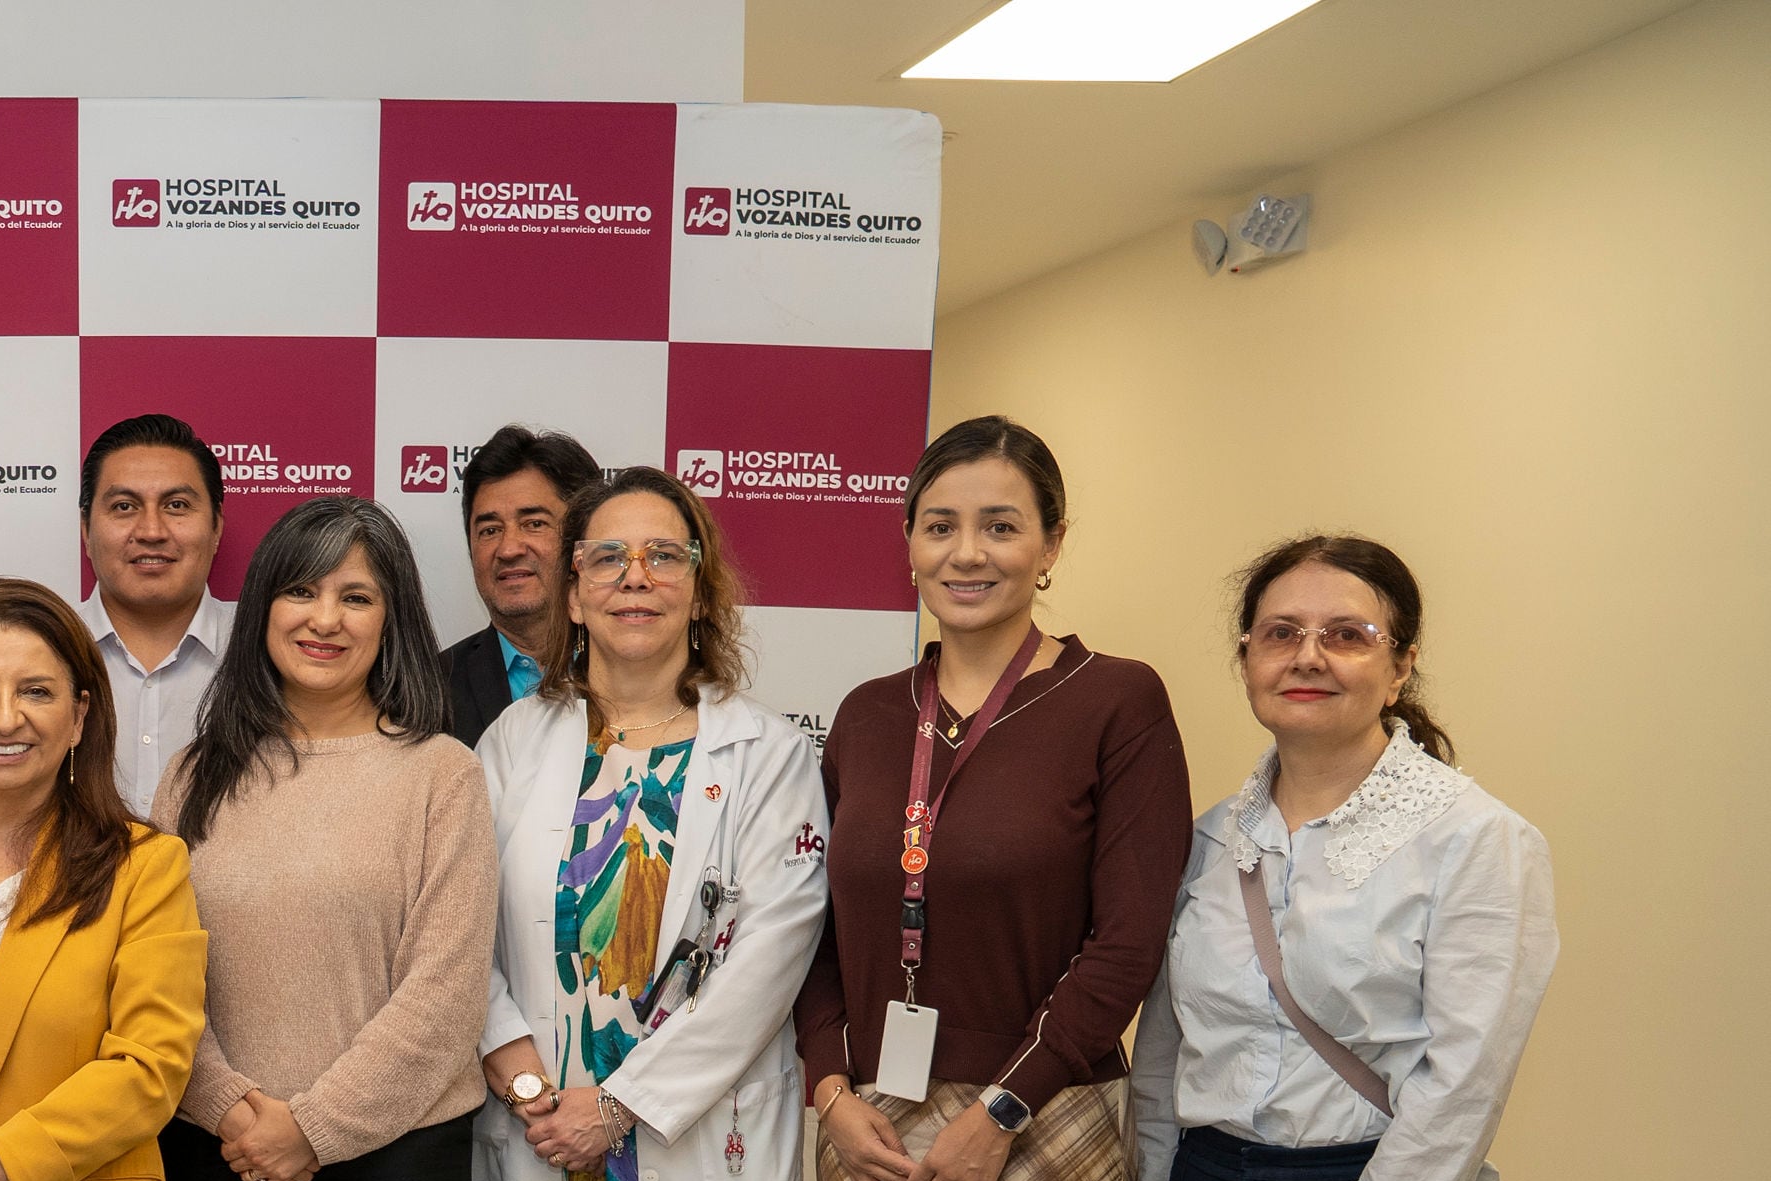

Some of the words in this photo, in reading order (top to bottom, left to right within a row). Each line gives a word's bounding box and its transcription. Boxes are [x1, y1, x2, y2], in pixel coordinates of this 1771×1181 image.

[165, 178, 285, 196] HOSPITAL
[460, 182, 578, 201] HOSPITAL
[736, 188, 850, 210] HOSPITAL
[166, 199, 286, 215] VOZANDES
[292, 200, 360, 219] QUITO
[460, 202, 579, 220] VOZANDES
[584, 204, 651, 223] QUITO
[7, 220, 22, 228] del
[24, 220, 62, 228] Ecuador
[185, 220, 211, 229] gloria
[228, 220, 248, 228] Dios
[250, 222, 256, 230] y
[268, 220, 303, 229] servicio
[305, 221, 320, 229] del
[469, 223, 478, 231] la
[479, 223, 505, 233] gloria
[507, 224, 519, 232] de
[521, 224, 541, 232] Dios
[543, 226, 549, 234] y
[560, 224, 596, 233] servicio
[597, 225, 611, 234] del
[613, 226, 650, 234] Ecuador
[736, 208, 850, 228] VOZANDES
[856, 214, 921, 232] QUITO
[744, 229, 751, 237] la
[754, 230, 779, 239] gloria
[780, 231, 792, 239] de
[794, 231, 814, 240] Dios
[833, 234, 867, 242] servicio
[884, 236, 920, 244] Ecuador
[214, 445, 278, 462] PITAL
[728, 450, 841, 470] HOSPITAL
[222, 464, 278, 480] NDES
[284, 464, 351, 483] QUITO
[728, 470, 841, 488] VOZANDES
[846, 474, 909, 492] QUITO
[745, 491, 770, 500] gloria
[785, 492, 805, 500] Dios
[823, 493, 857, 502] servicio
[858, 494, 872, 502] del
[874, 495, 905, 504] Ecuado
